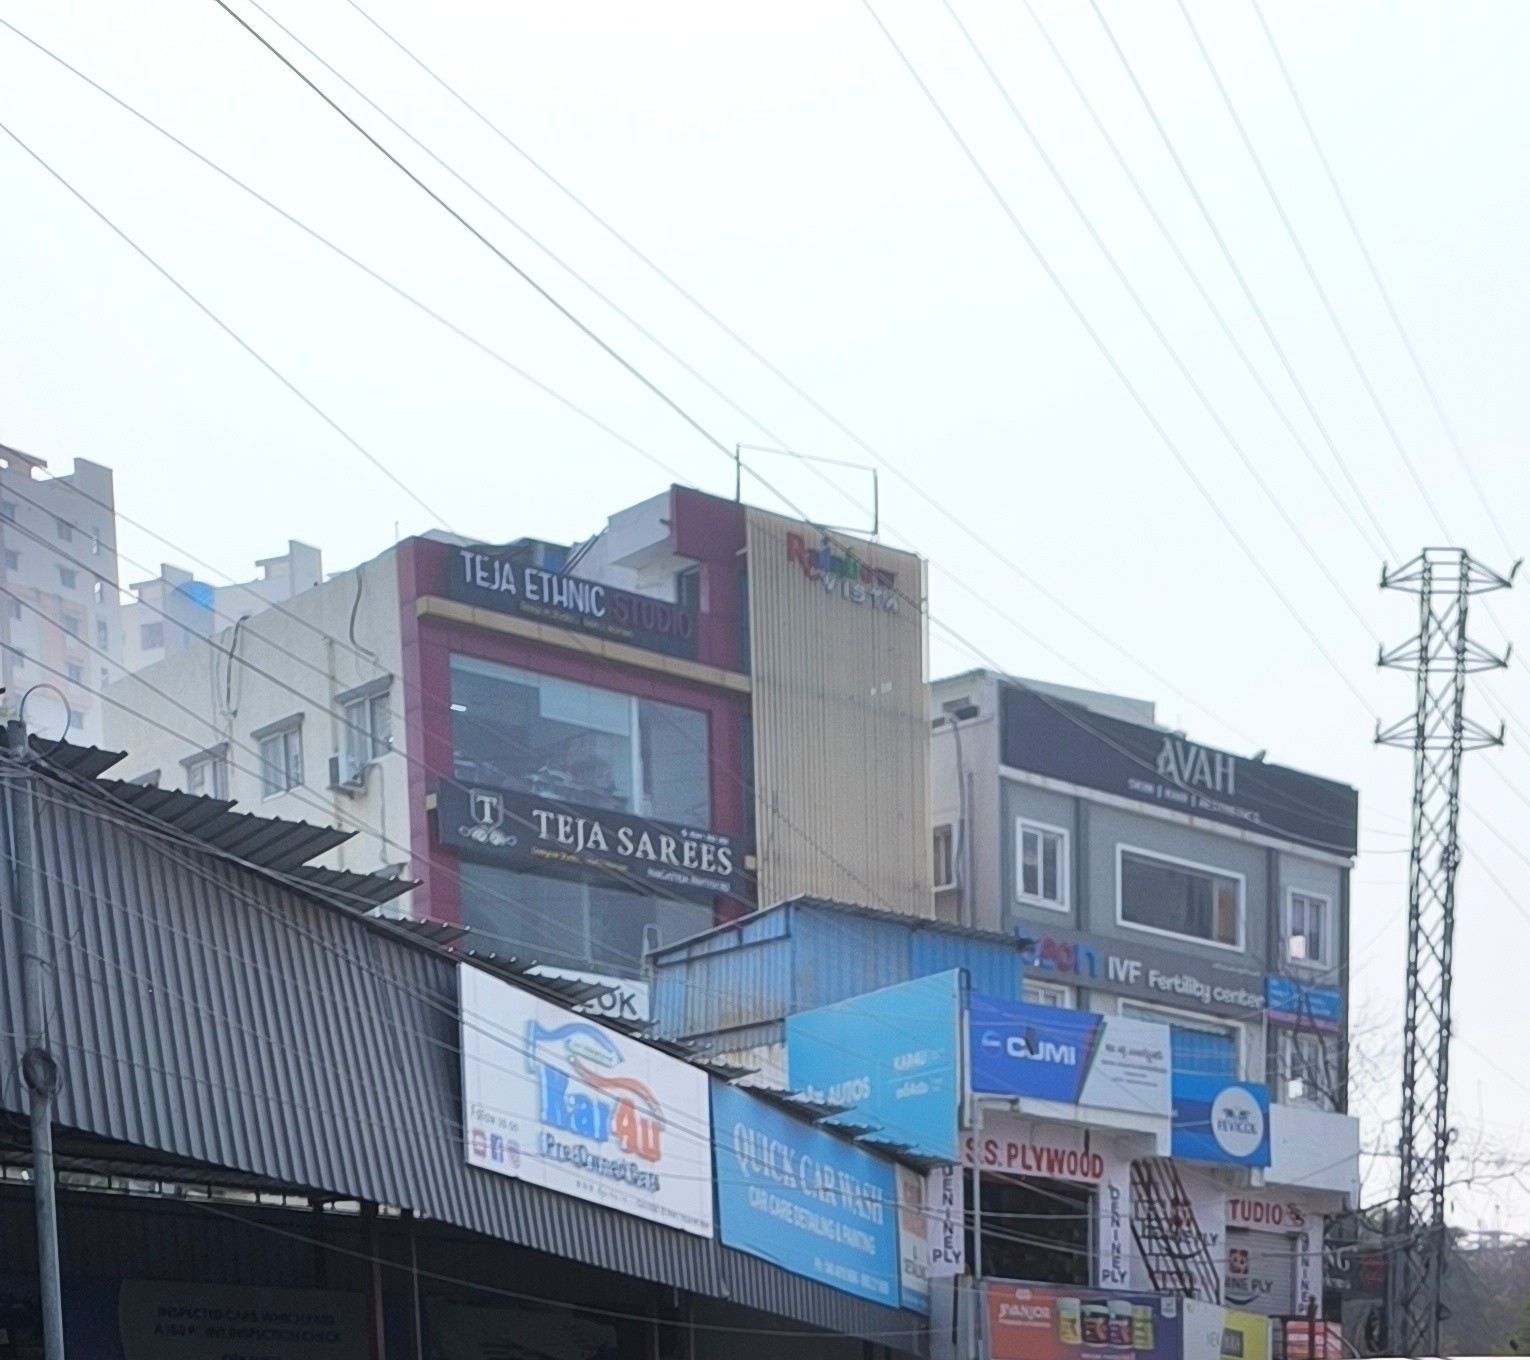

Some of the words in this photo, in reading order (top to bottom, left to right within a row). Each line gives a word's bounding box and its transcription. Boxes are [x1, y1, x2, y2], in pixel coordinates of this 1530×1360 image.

[460, 550, 517, 596] TEJA
[524, 567, 606, 618] ETHNIC
[612, 591, 693, 640] STUDIO
[1156, 736, 1236, 796] AVAH
[532, 809, 610, 853] TEJA
[617, 826, 734, 876] SAREES
[1107, 955, 1142, 985] IVF
[1148, 969, 1212, 1004] Fertility
[733, 1121, 797, 1190] QUICK
[800, 1154, 838, 1207] CAR
[837, 1169, 884, 1227] WASH
[1006, 1142, 1105, 1179] PLYWOOD
[932, 1249, 962, 1265] PLY
[1101, 1268, 1128, 1285] PLY
